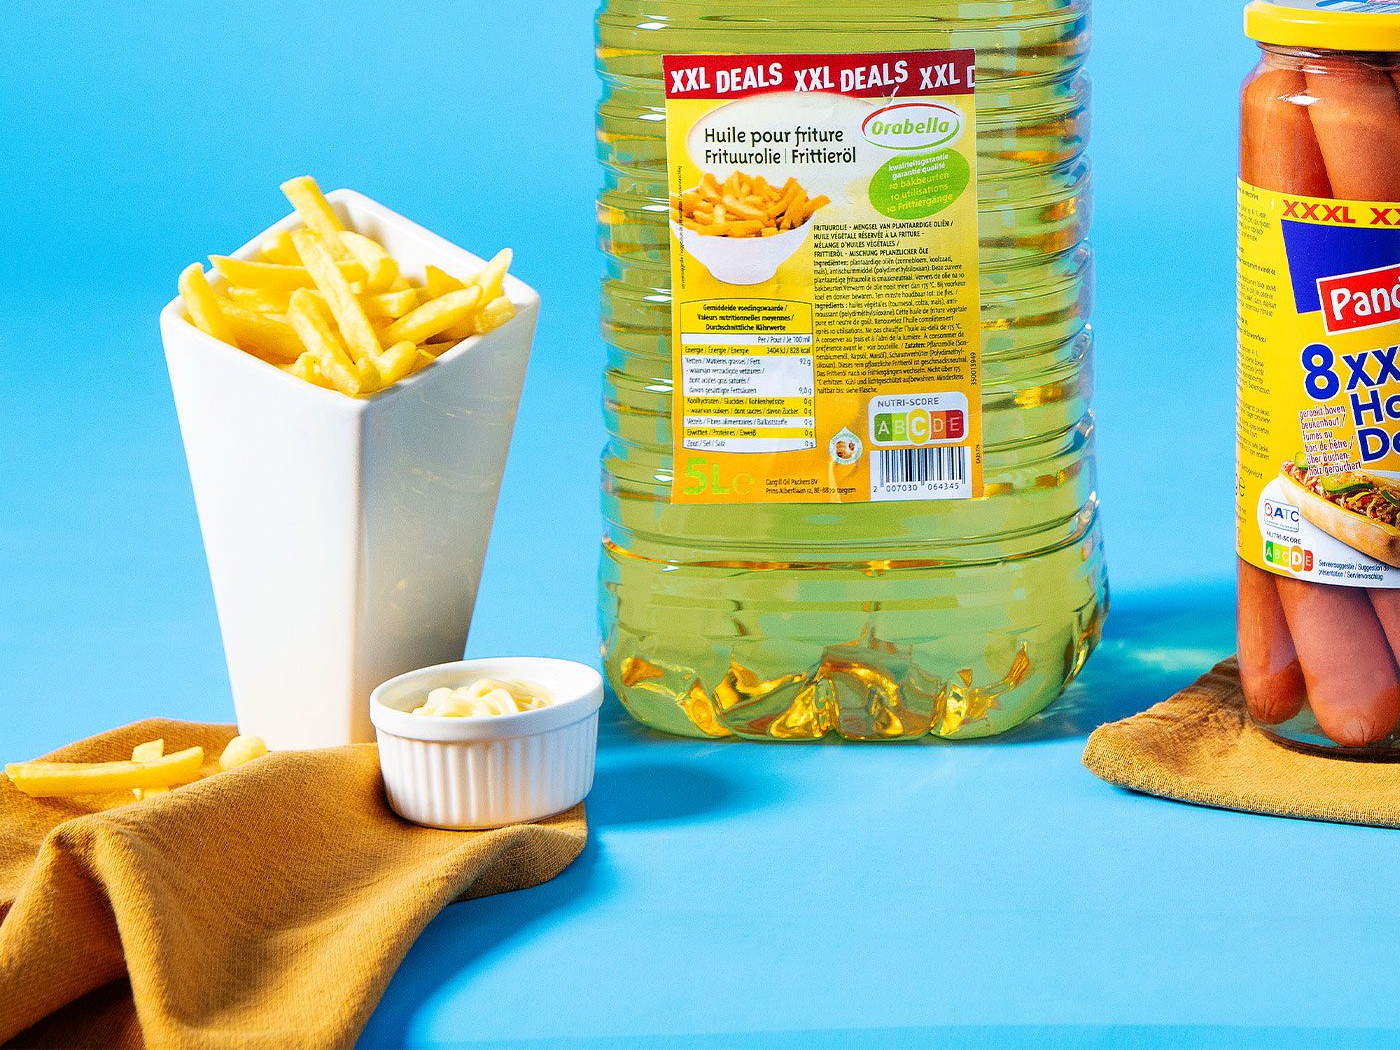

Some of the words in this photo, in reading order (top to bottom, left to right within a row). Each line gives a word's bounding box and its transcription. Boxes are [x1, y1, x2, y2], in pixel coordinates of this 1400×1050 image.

[671, 67, 711, 94] XXL
[716, 63, 782, 94] DEALS
[794, 66, 834, 92] XXL
[840, 60, 908, 92] DEALS
[919, 62, 960, 90] XXL
[871, 117, 949, 135] Orabella
[705, 127, 745, 143] Huile
[751, 131, 791, 147] pour
[795, 126, 843, 147] friture
[705, 148, 781, 164] Frituurolie
[792, 147, 856, 163] Frittieröl
[888, 153, 949, 171] kwaliteitsgarantie
[892, 167, 920, 180] garantie
[900, 172, 949, 188] bakbeurten
[901, 182, 948, 198] utilisations
[887, 205, 896, 213] 10
[1282, 199, 1355, 223] XXXL
[892, 221, 932, 229] PLANTAARDIGE
[1301, 344, 1341, 401] 8
[877, 397, 939, 408] NUTRI-SCORE
[1324, 404, 1346, 414] boven
[878, 423, 890, 434] A
[895, 420, 905, 434] B
[912, 417, 926, 436] C
[934, 418, 943, 432] D
[950, 417, 960, 431] E
[1320, 441, 1327, 451] de
[886, 484, 918, 492] 007030
[928, 482, 959, 491] 064345
[1274, 507, 1299, 522] ATC
[1267, 531, 1301, 544] NUTRI-SCORE
[1266, 546, 1272, 557] A
[1275, 550, 1279, 559] B
[1292, 552, 1300, 565] D
[1306, 556, 1312, 566] E
